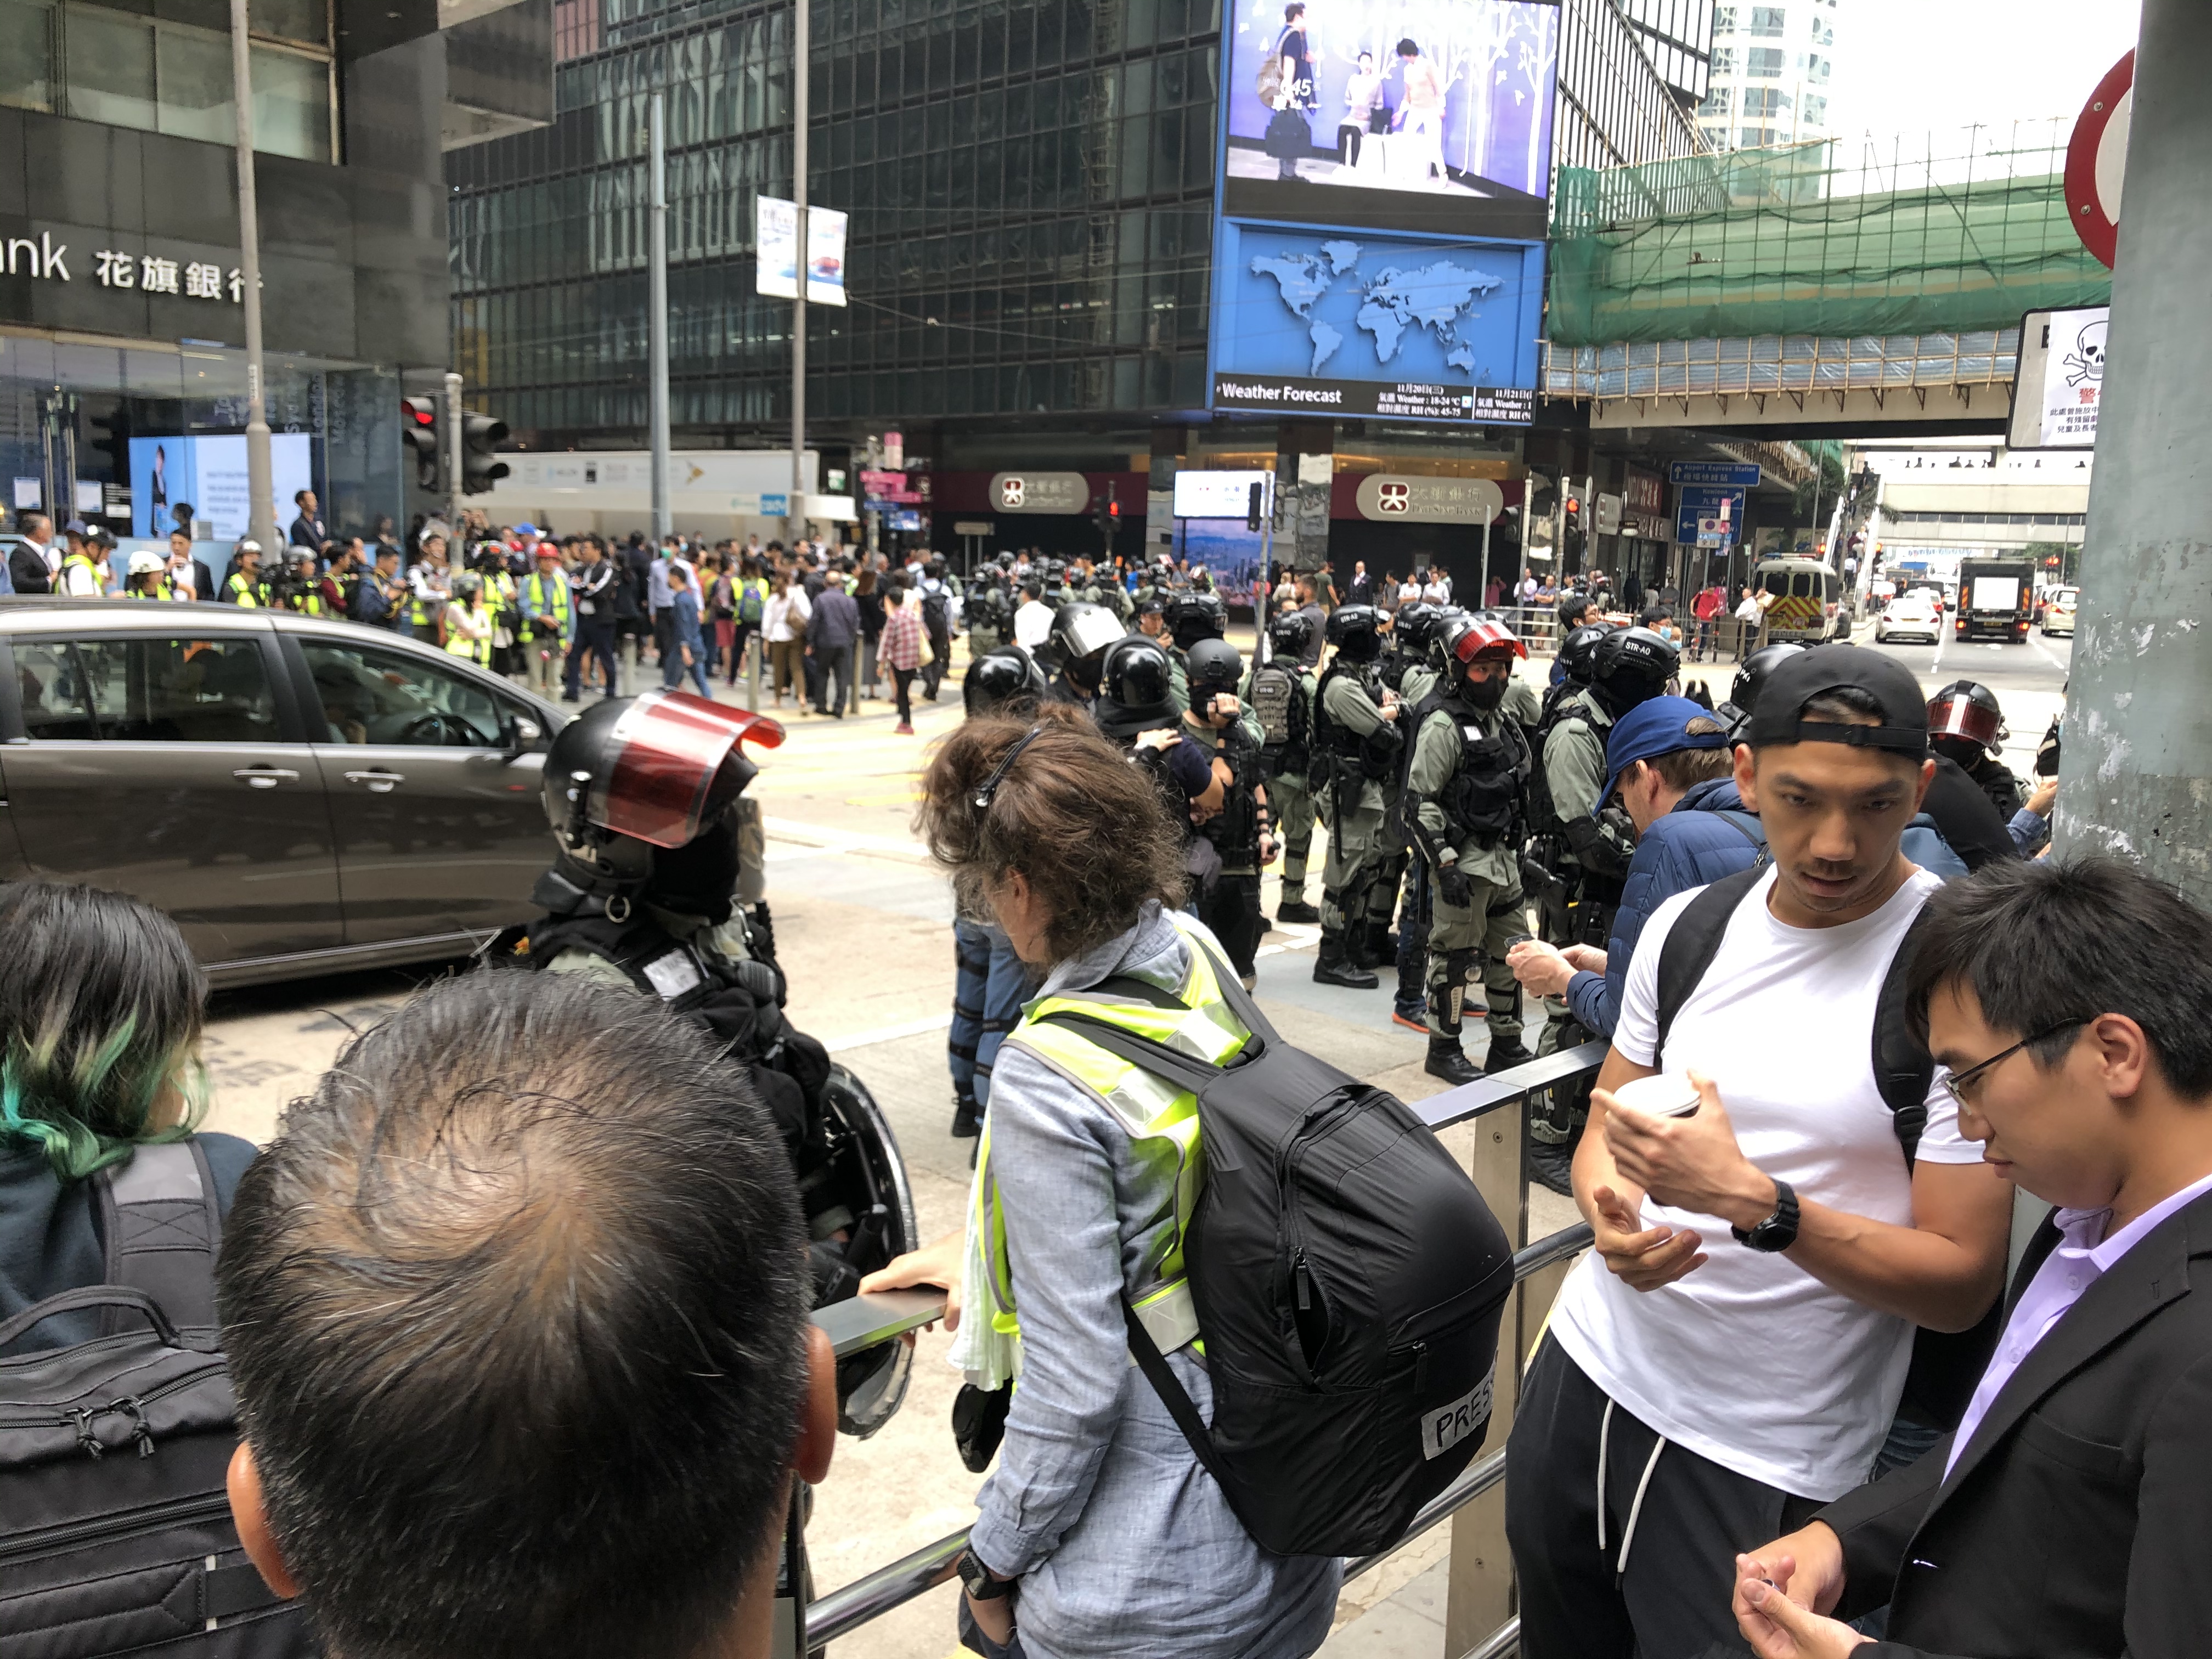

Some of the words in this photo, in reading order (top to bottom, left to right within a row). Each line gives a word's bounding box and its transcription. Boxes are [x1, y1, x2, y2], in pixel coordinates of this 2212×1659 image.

[0, 231, 70, 281] nk
[1222, 382, 1282, 400] Weather
[1283, 386, 1342, 404] Forecast
[1397, 394, 1425, 404] Weather
